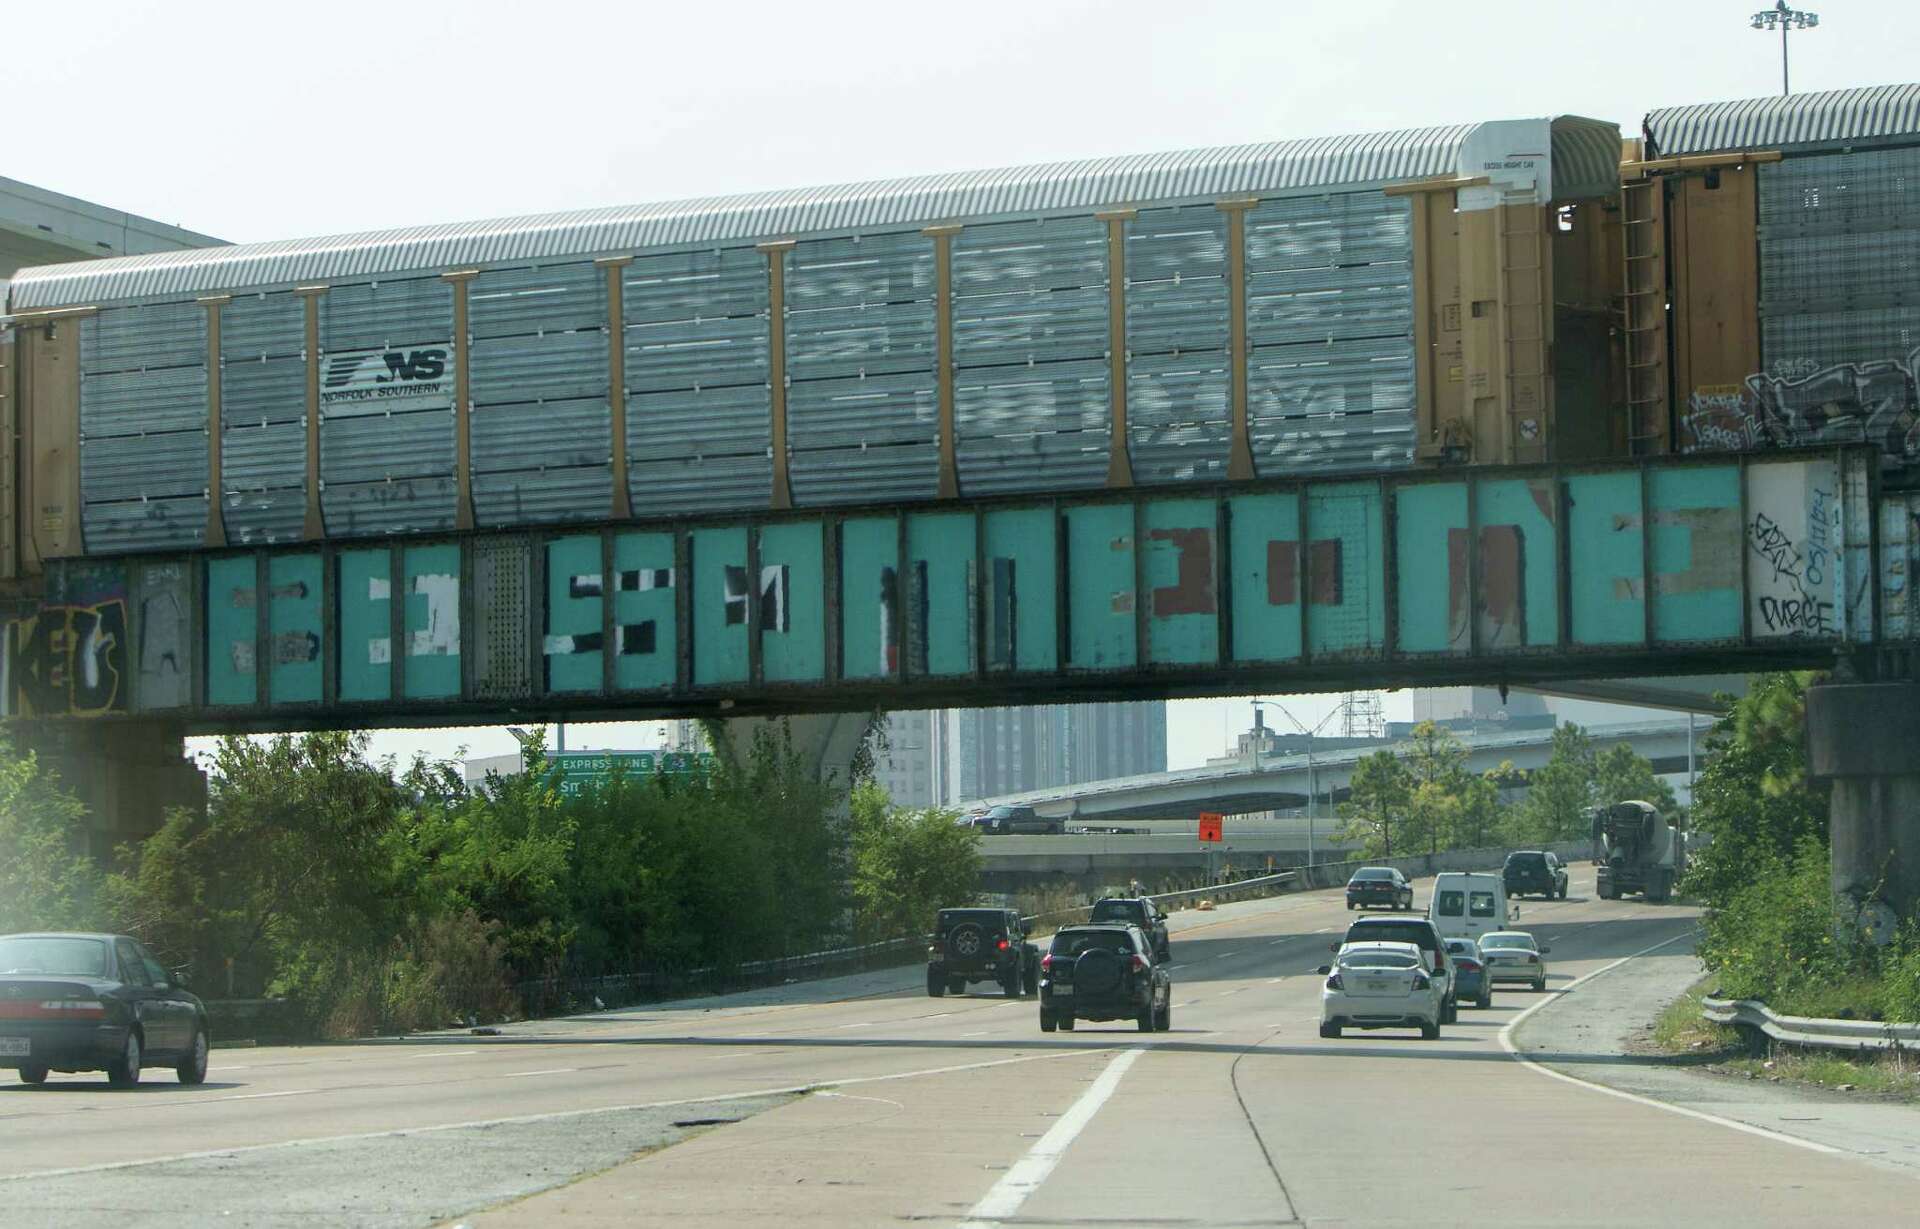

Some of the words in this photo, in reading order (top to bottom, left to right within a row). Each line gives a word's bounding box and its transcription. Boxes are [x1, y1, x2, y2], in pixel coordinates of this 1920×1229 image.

[322, 387, 372, 402] NORFOLK
[378, 383, 441, 399] SOUTHERN
[1760, 596, 1834, 634] PURGE
